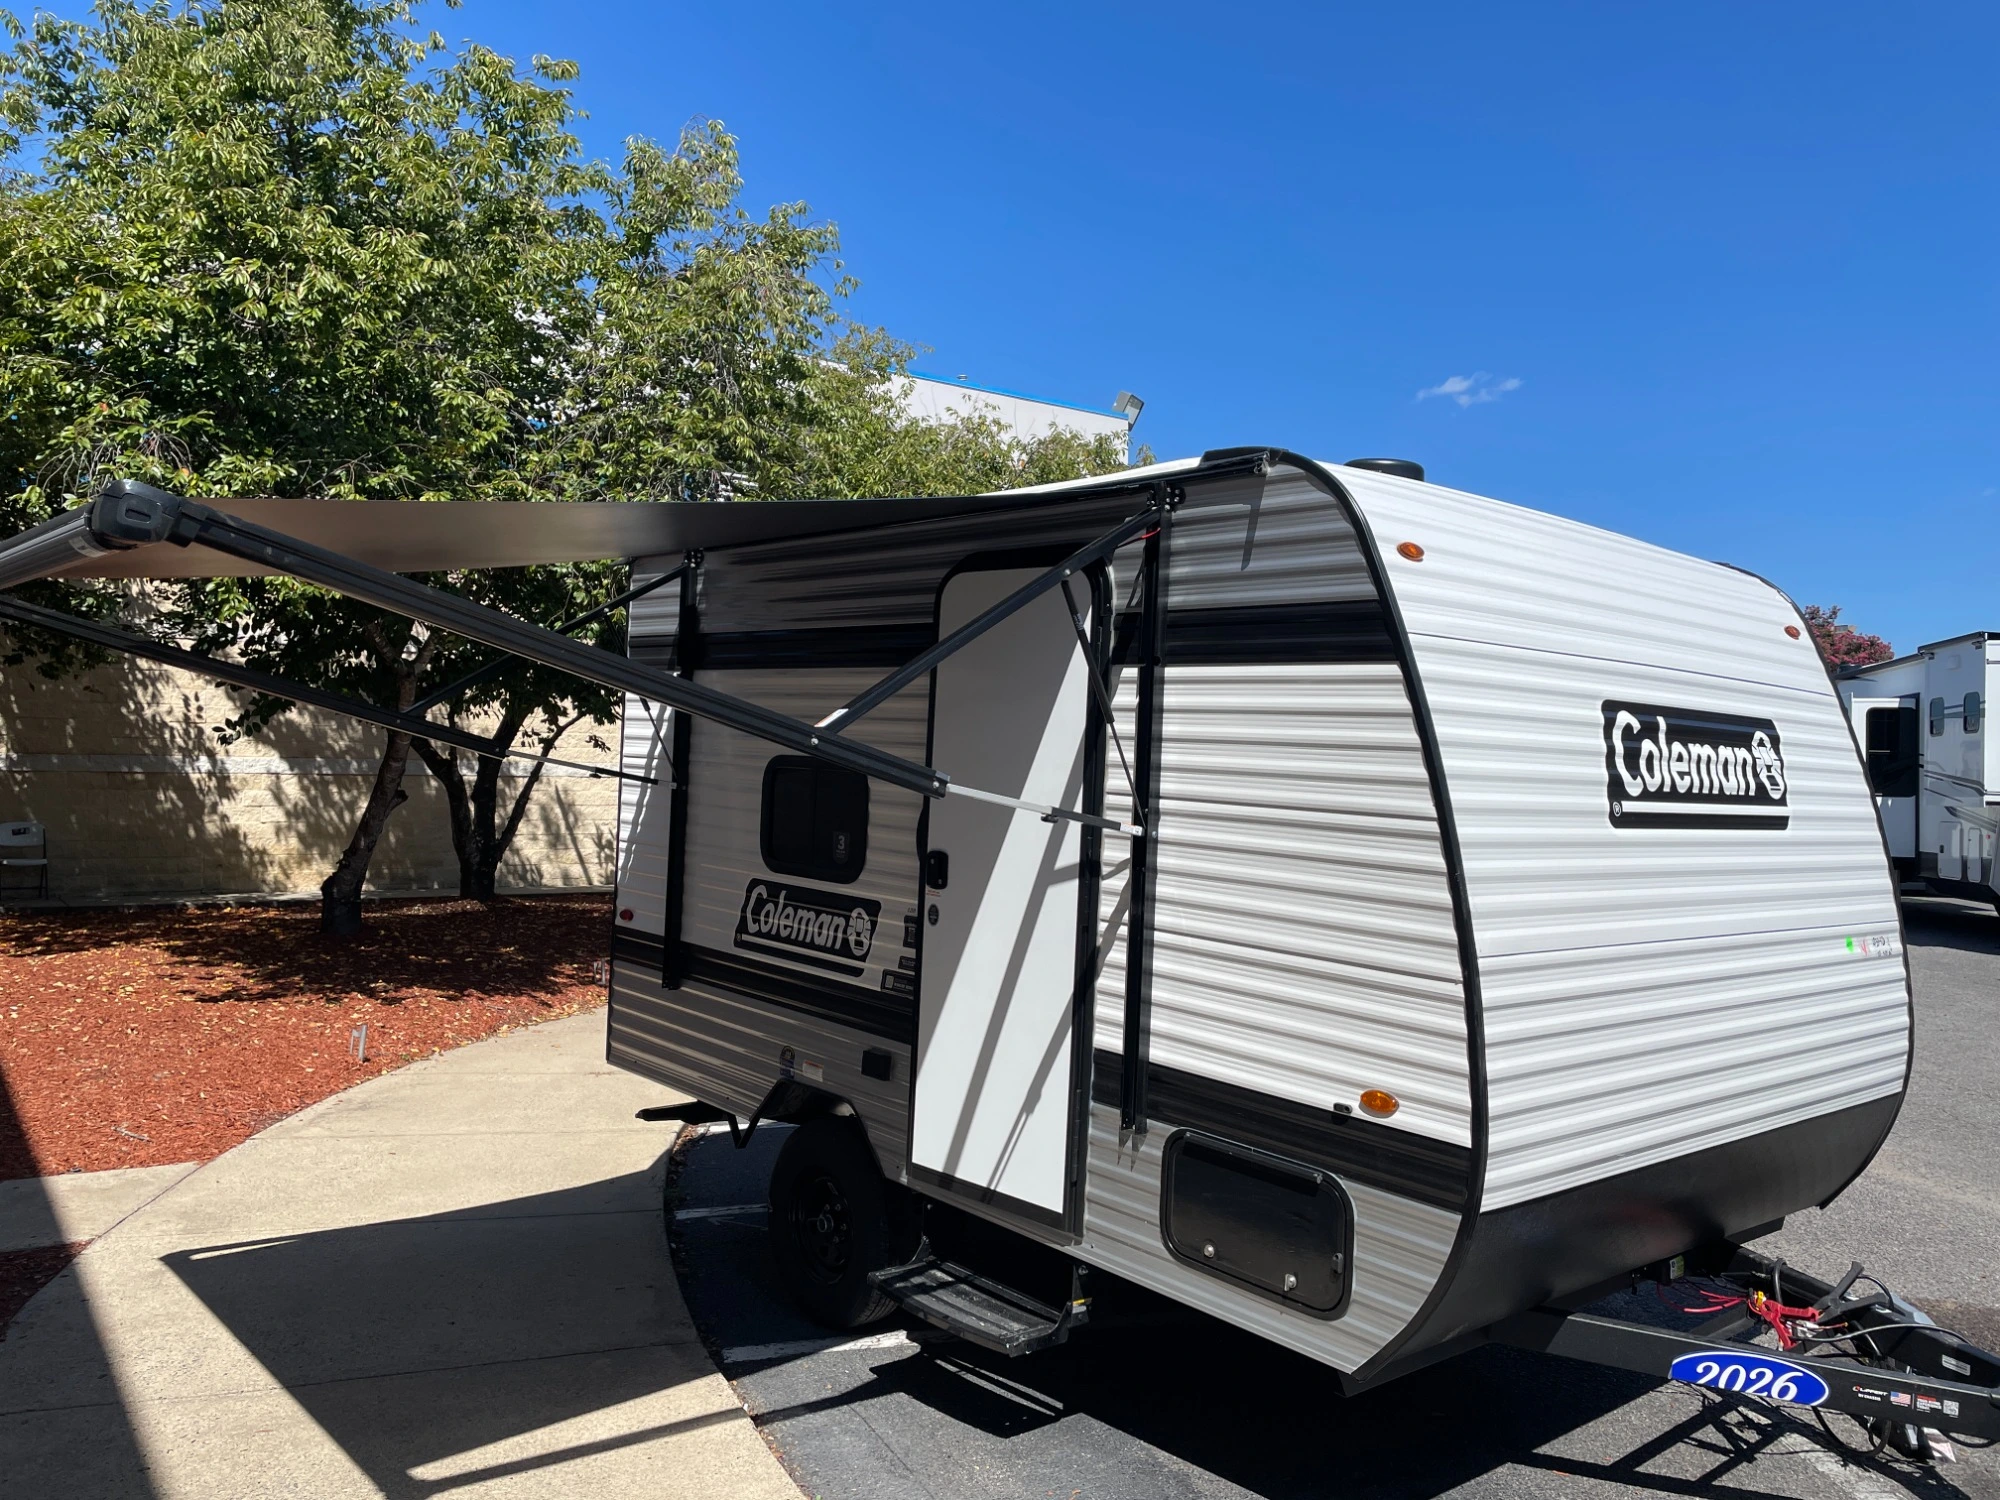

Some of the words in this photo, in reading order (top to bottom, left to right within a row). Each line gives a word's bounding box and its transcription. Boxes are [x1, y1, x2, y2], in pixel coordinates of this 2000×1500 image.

[1612, 710, 1756, 797] Coleman
[746, 884, 846, 950] Coleman
[1695, 1361, 1804, 1401] 2026
